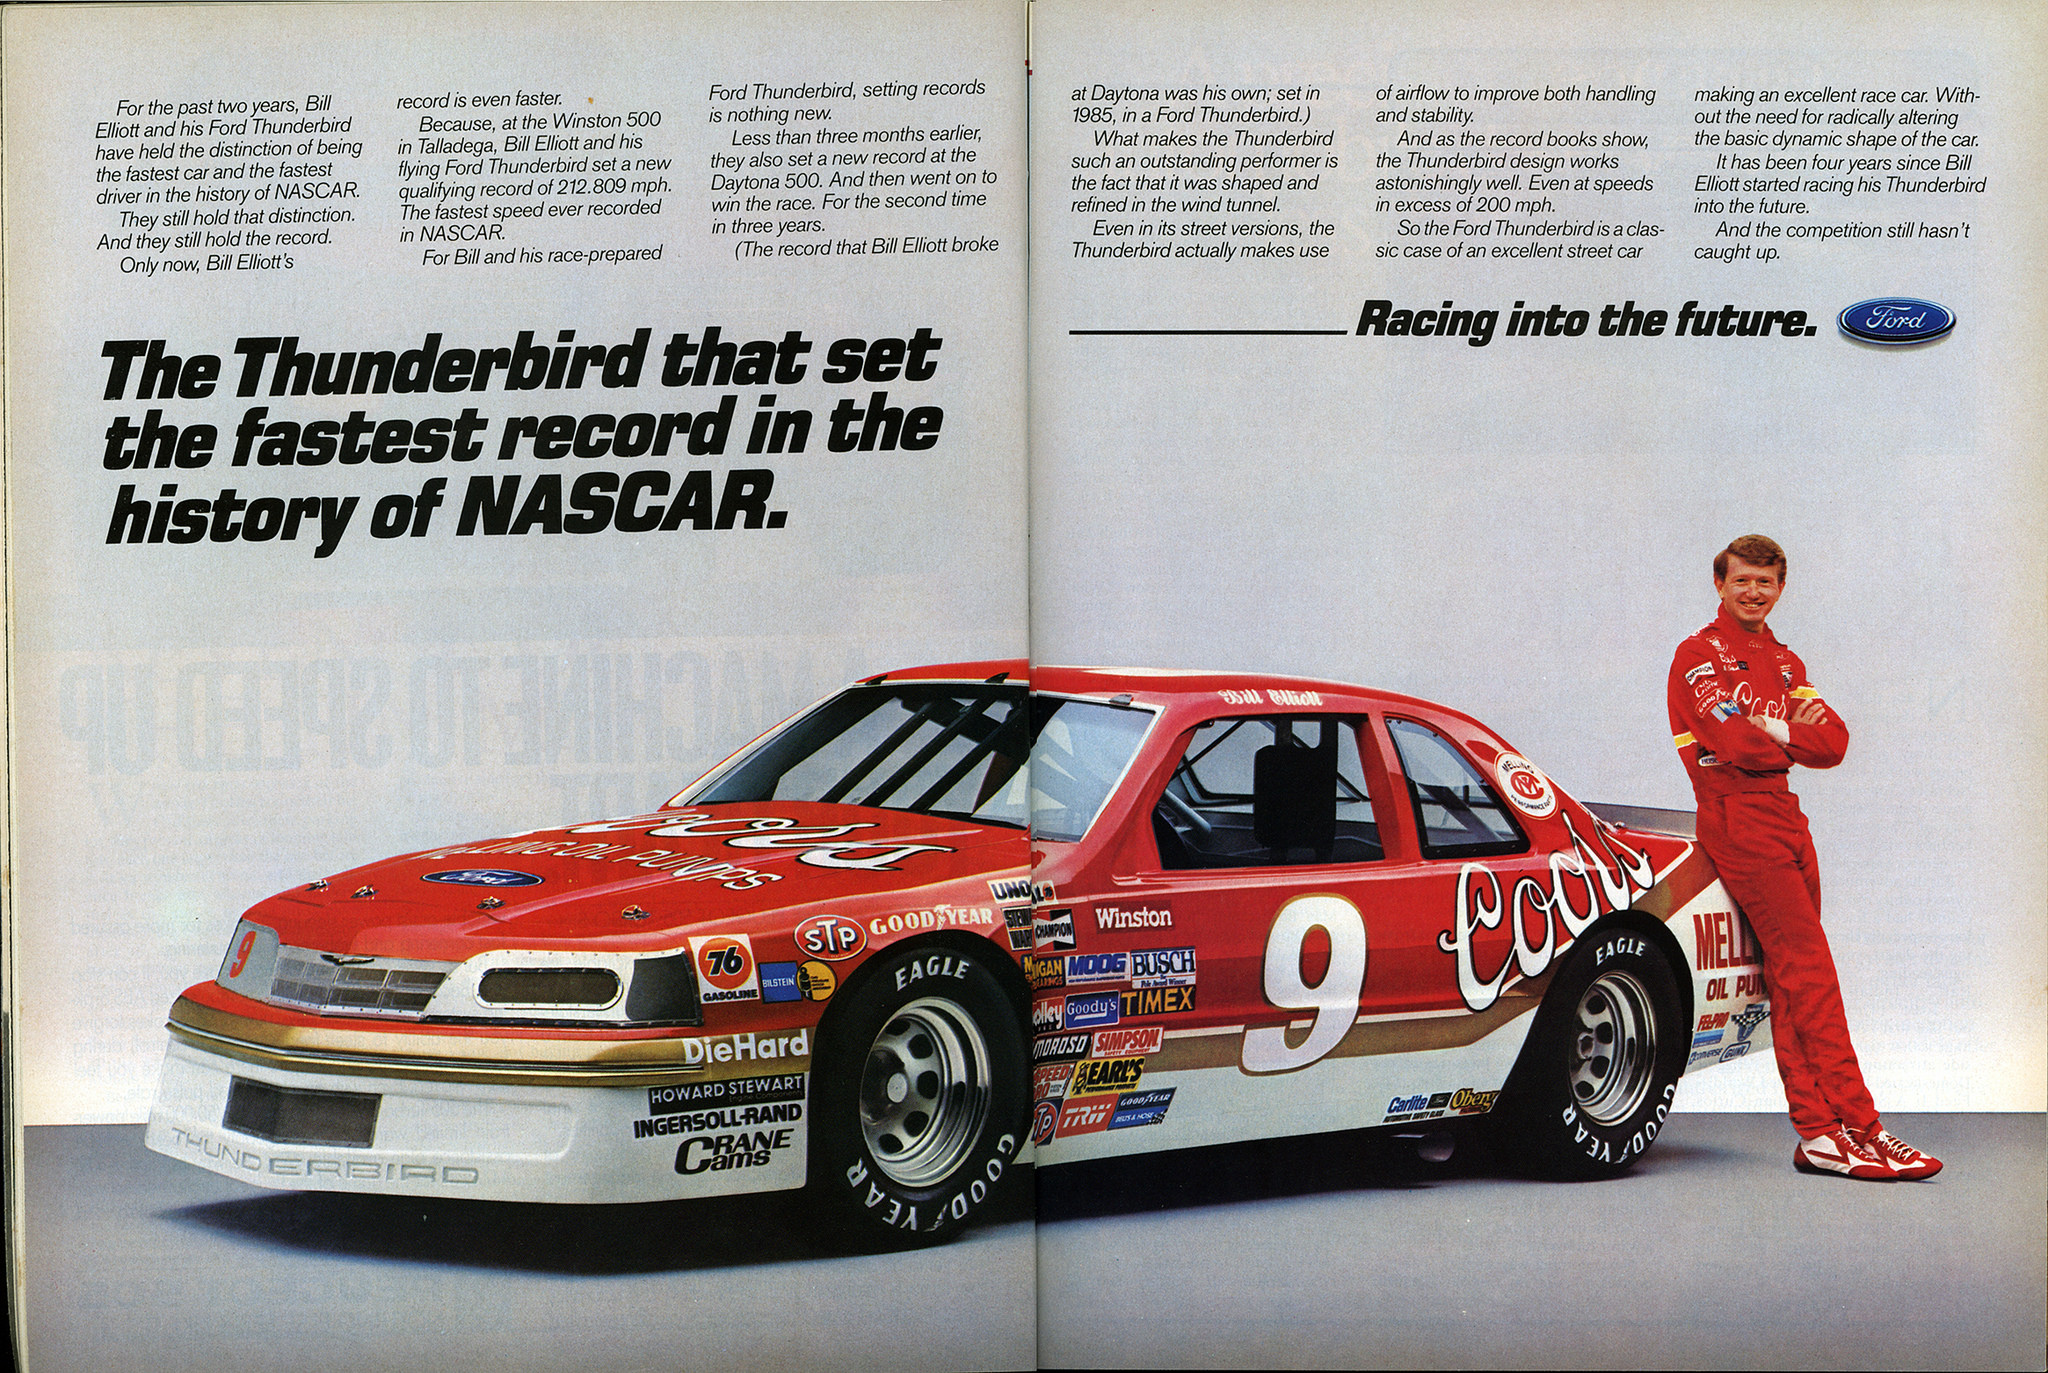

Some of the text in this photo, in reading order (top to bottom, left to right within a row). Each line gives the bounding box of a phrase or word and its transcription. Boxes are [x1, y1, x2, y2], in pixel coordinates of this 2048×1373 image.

[708, 78, 986, 101] Ford Thunderbird, setting records
[95, 115, 353, 139] Elliott and his Ford Thunderbird
[419, 110, 662, 134] Because, at the Winston 500
[1072, 105, 1311, 126] 1985, in a Ford Thunderbird.)
[1070, 151, 1339, 173] such an outstanding performer is
[1376, 151, 1620, 174] the Thunderbird design works
[96, 181, 360, 206] driver in the history of NASCAR.
[398, 175, 672, 204] qualifying record of 212.809 mph.
[1375, 173, 1654, 196] astonishingly well. Even at speeds
[1694, 174, 1988, 197] Elliott started racing his Thunderbird
[1714, 220, 1971, 242] And the competition still hasn't
[735, 235, 1000, 261] (The record that Bill Elliott broke
[1356, 300, 1817, 347] Racing into the future.
[1866, 304, 1926, 330] Ford
[101, 327, 943, 400] The Thunderbird that set
[103, 392, 943, 470] the fastest record in the
[106, 469, 788, 558] history of NASCAR.
[1218, 688, 1324, 706] Bill Elliott
[869, 904, 994, 936] GOODYEAR
[1095, 906, 1173, 930] Winston
[1437, 809, 1656, 1013] Coors
[803, 918, 859, 955] STP
[1035, 922, 1073, 940] CHAMPION
[229, 930, 257, 979] 9
[704, 946, 745, 977] 76
[1068, 953, 1127, 976] MOOG
[1131, 951, 1196, 977] BUSCH
[1595, 937, 1646, 967] EAGLE
[762, 978, 795, 988] BILSTEIN
[895, 956, 971, 992] EAGLE
[1239, 892, 1368, 1076] 9
[702, 988, 759, 1002] GASOLINE
[1121, 987, 1193, 1016] TIMEX
[1706, 977, 1729, 1001] OIL
[1066, 998, 1118, 1016] Goody's
[682, 1028, 810, 1065] DieHard
[1032, 1034, 1089, 1060] MOROSO
[1095, 1029, 1159, 1053] SIMPSON
[1086, 1057, 1145, 1085] EARL'S
[651, 1075, 803, 1105] HOWARD STEWART
[1120, 1093, 1172, 1107] GOODYEAR
[1450, 1089, 1498, 1112] Oberg
[1063, 1103, 1113, 1129] TRW
[1387, 1095, 1429, 1114] Carlite
[633, 1102, 803, 1140] INGERSOLL-RAND
[1563, 1083, 1676, 1165] GOODYEAR
[171, 1127, 480, 1185] THUNDERBIRD
[674, 1128, 795, 1176] CRANE
[846, 1133, 1016, 1233] GOODYEAR
